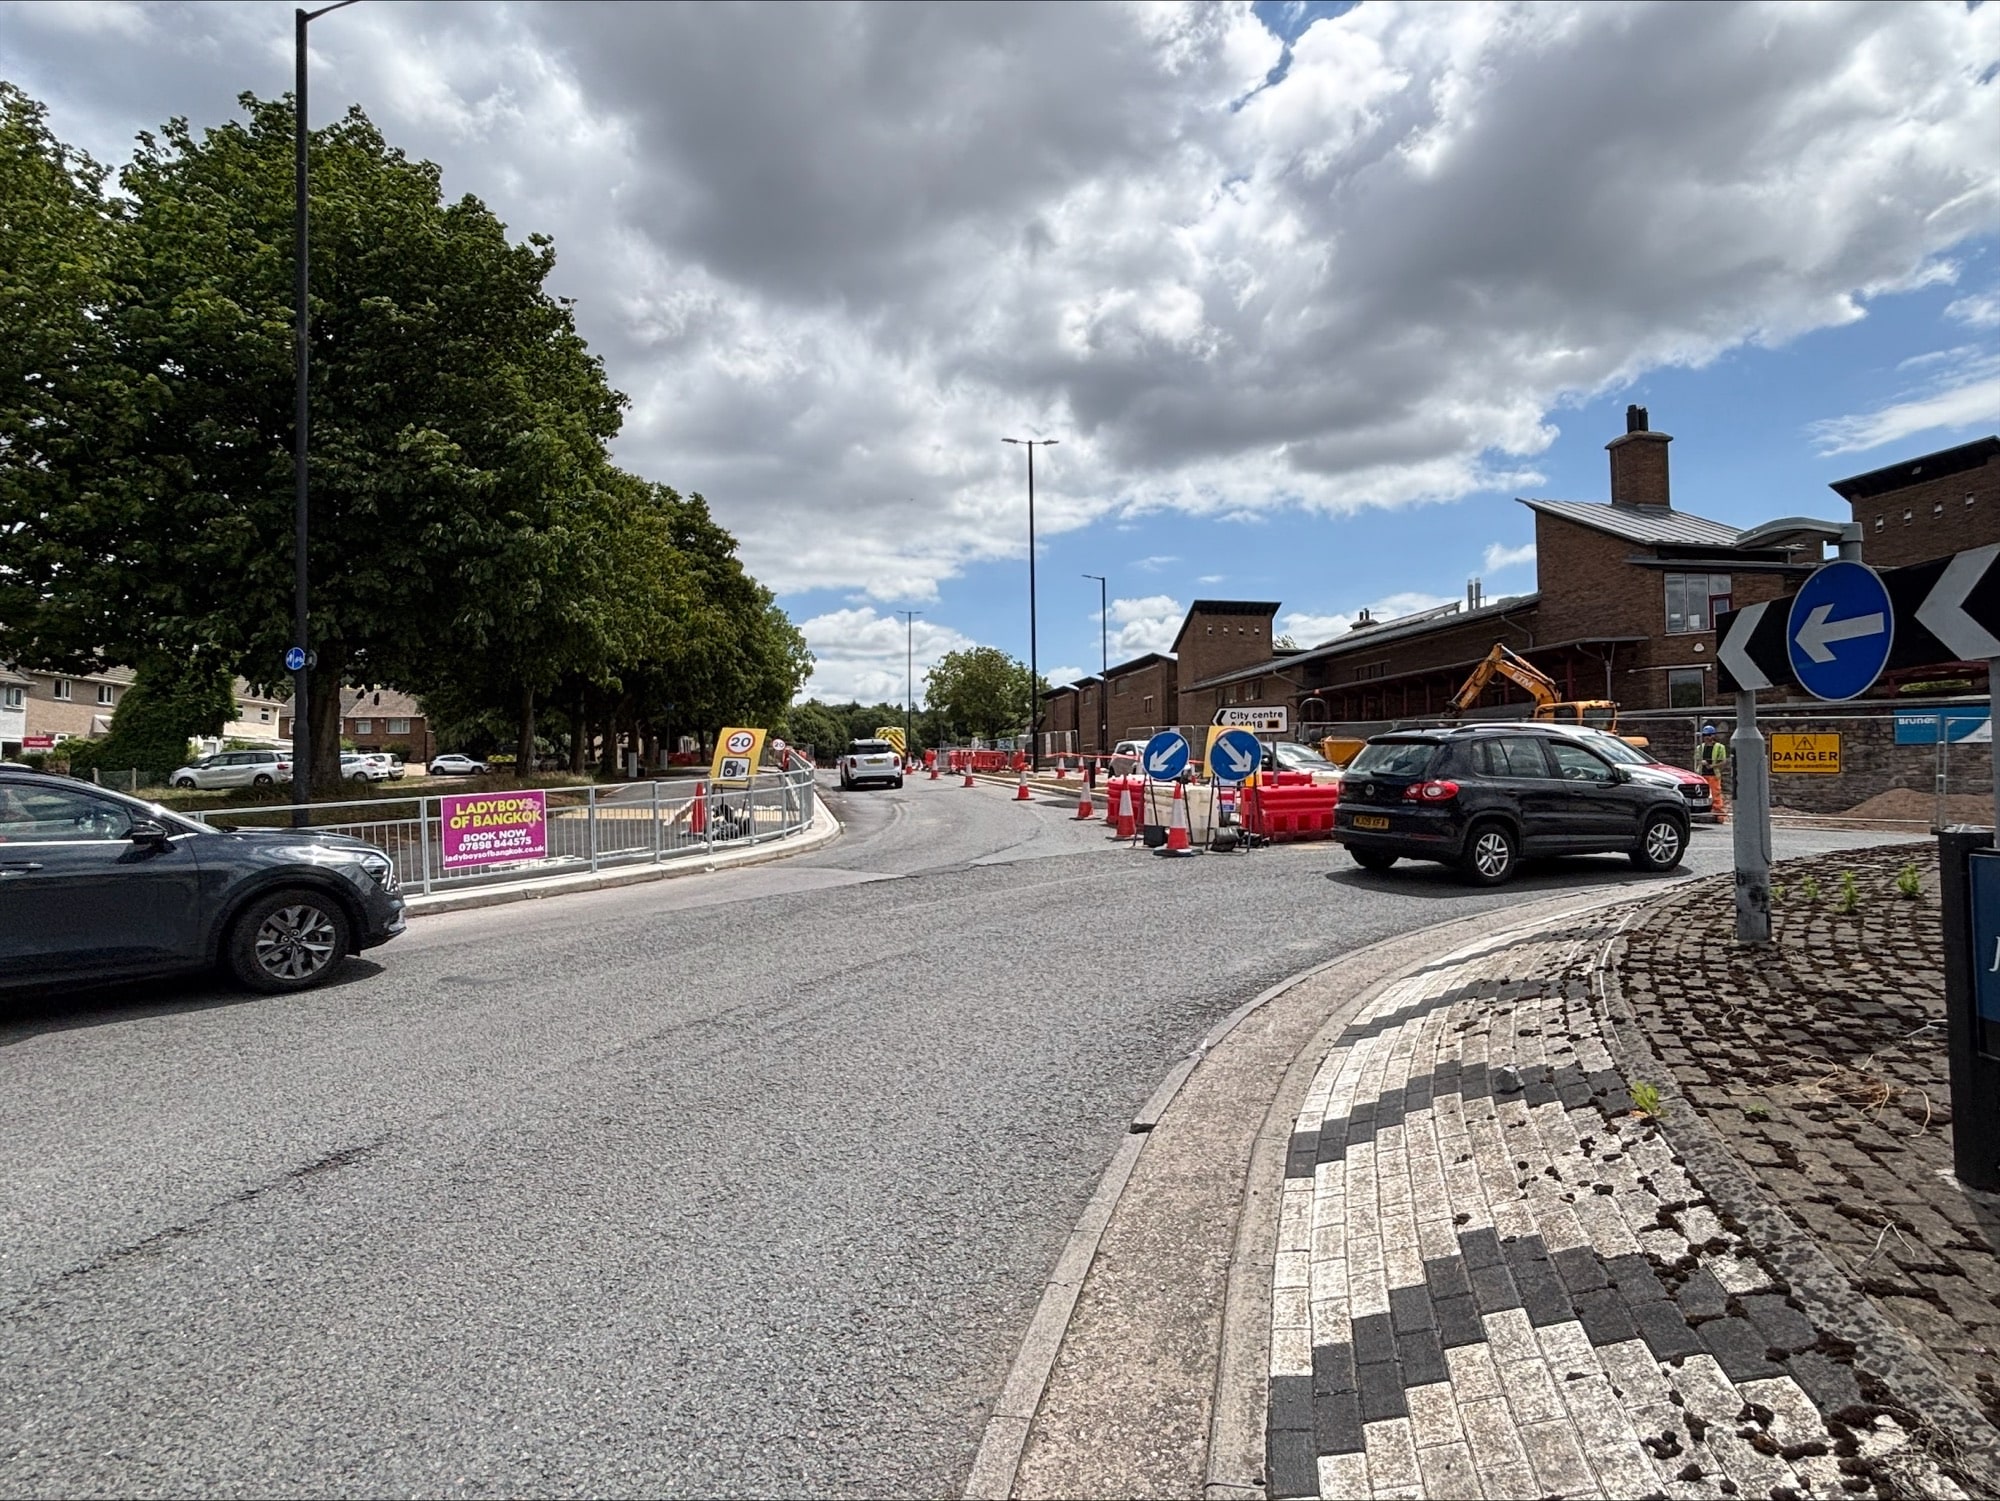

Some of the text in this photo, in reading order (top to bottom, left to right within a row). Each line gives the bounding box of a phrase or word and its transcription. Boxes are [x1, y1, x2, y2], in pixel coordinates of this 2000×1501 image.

[1229, 710, 1283, 721] City centre
[730, 737, 751, 747] 20
[1773, 751, 1838, 761] DANGER
[456, 798, 534, 816] LADYBOYS
[450, 810, 542, 829] OF BANGKOK
[463, 829, 527, 843] BOOK NOW
[493, 836, 532, 848] 844575
[446, 846, 544, 861] ladyboysofbangkok.co.uk
